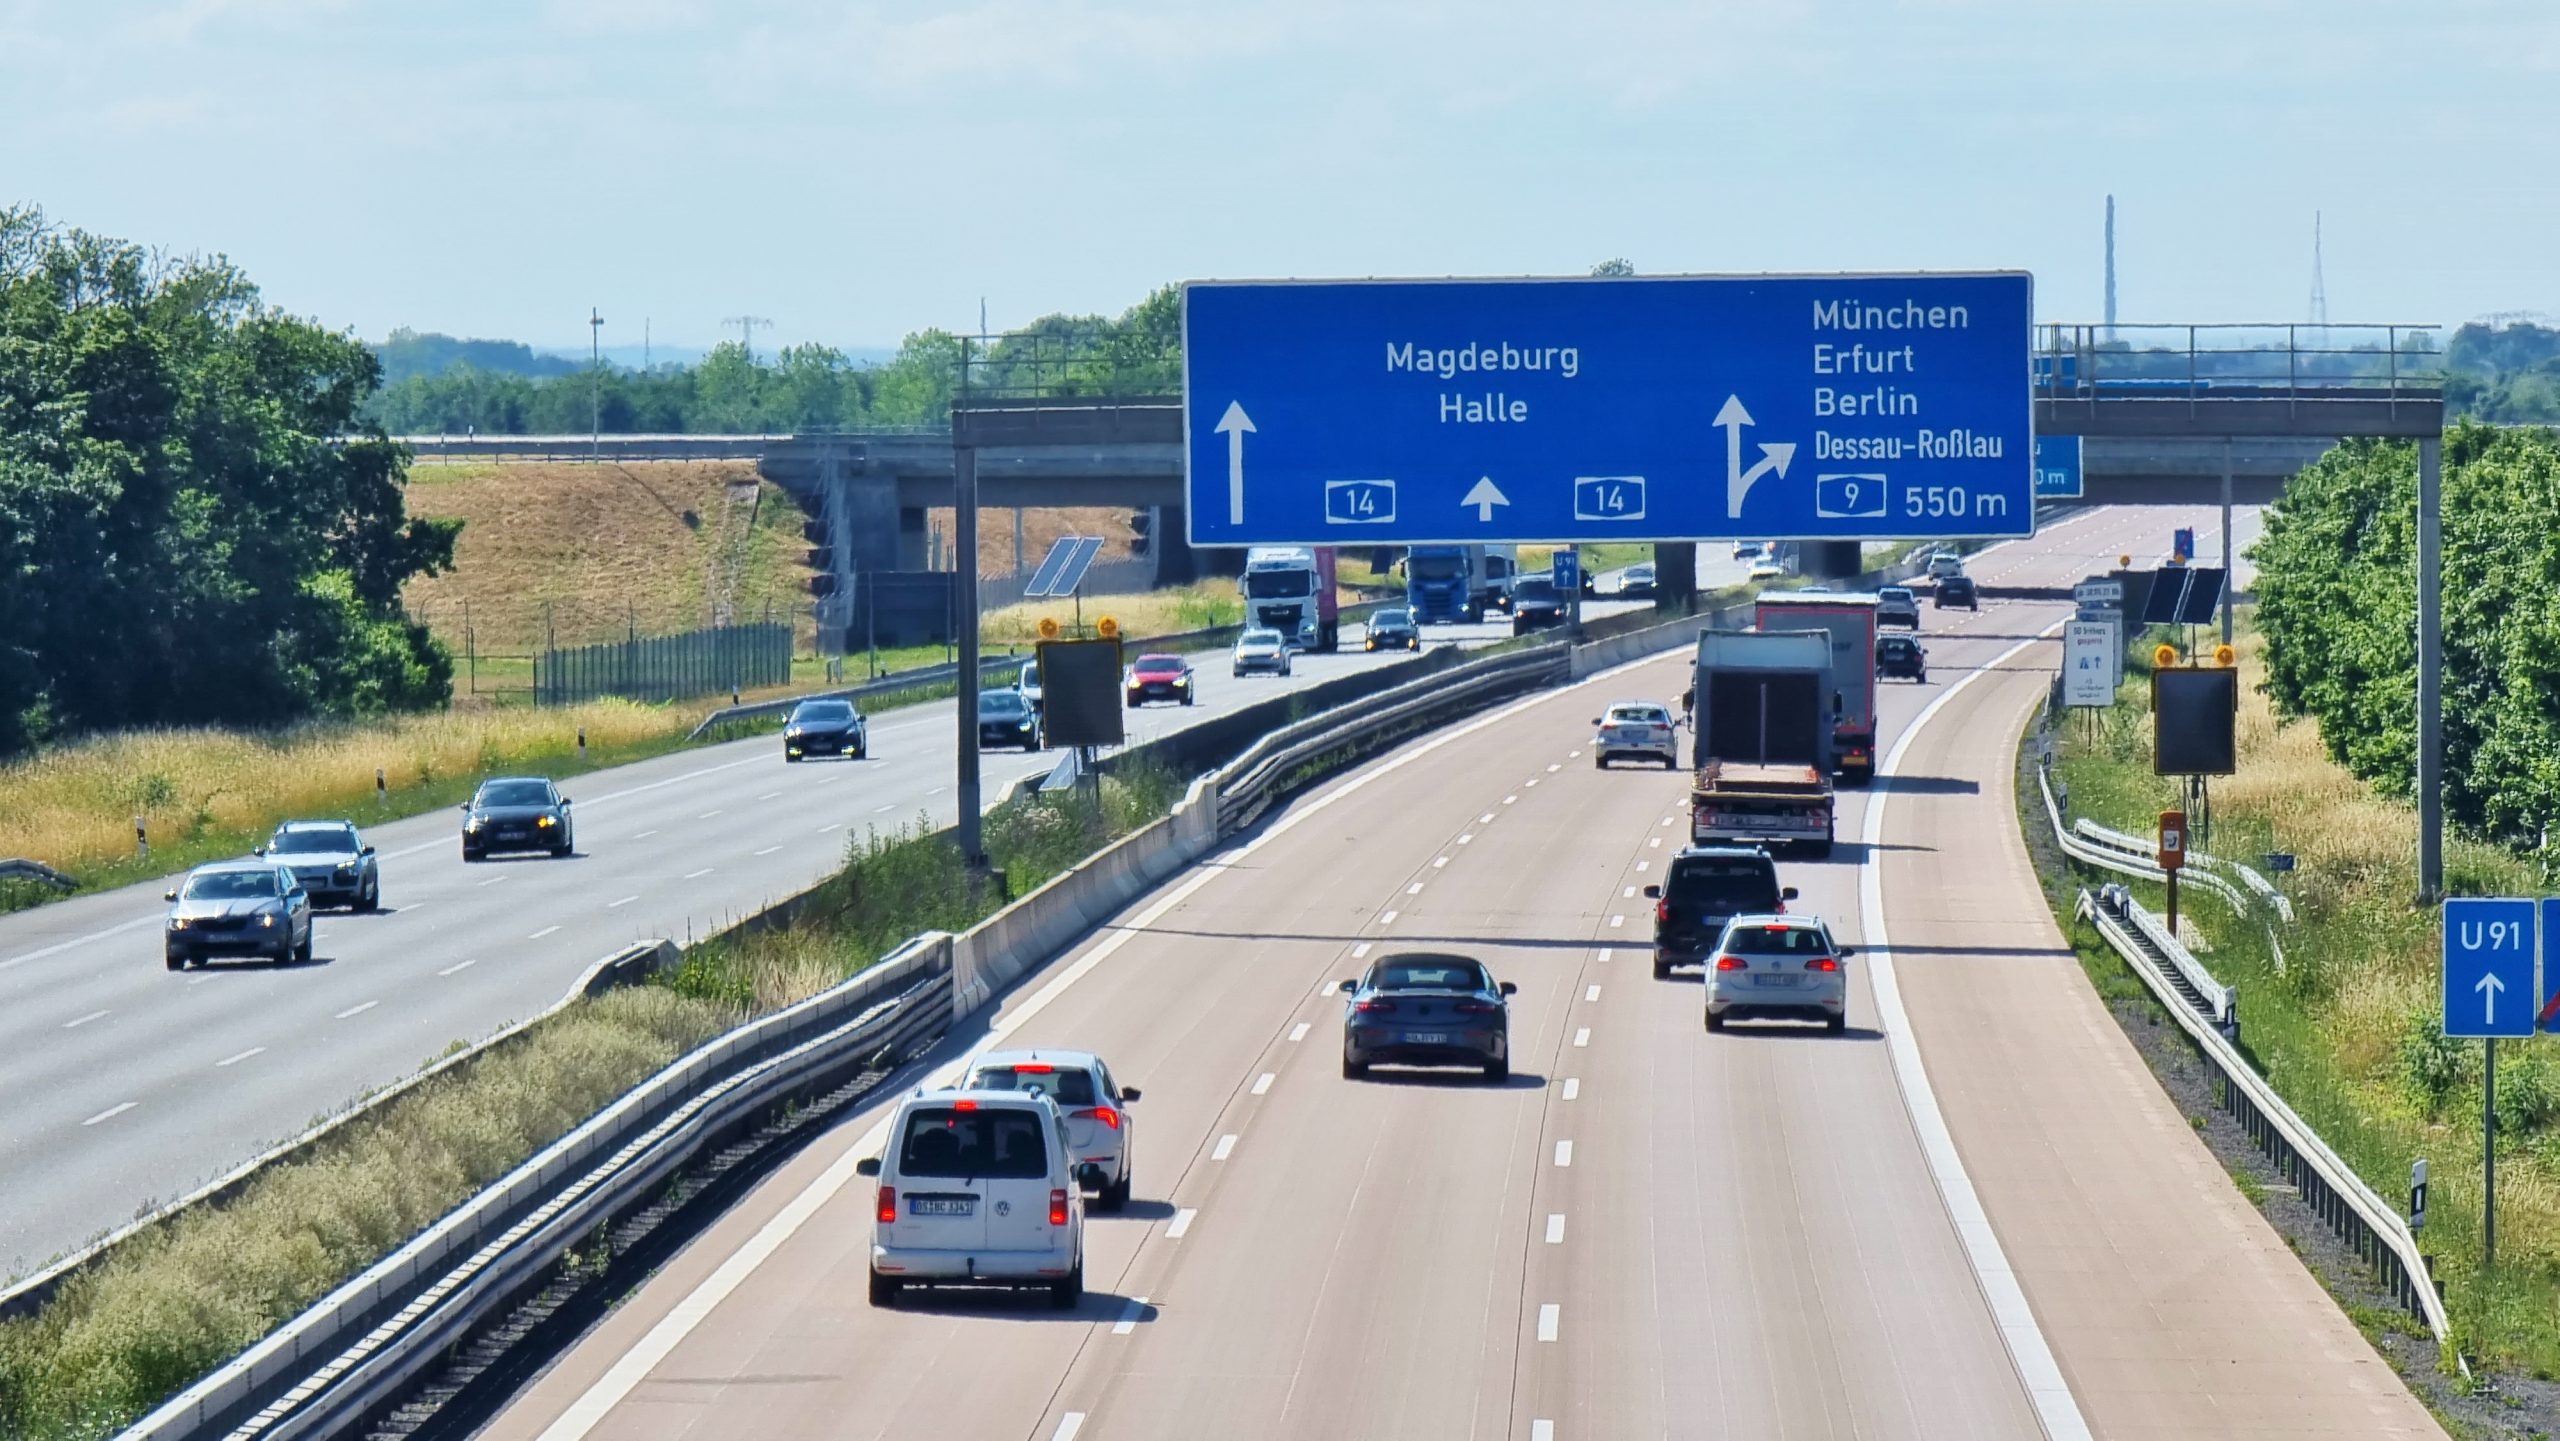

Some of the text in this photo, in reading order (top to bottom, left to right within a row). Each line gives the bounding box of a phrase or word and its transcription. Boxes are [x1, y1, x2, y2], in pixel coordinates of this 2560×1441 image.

[1814, 300, 1968, 330] München
[1387, 342, 1578, 379] Magdeburg
[1814, 344, 1914, 374] Erfurt
[1440, 393, 1528, 423] Halle
[1815, 387, 1918, 416] Berlin
[1816, 429, 2003, 460] Dessau-Roßlau
[1347, 490, 1374, 515] 14
[1596, 486, 1623, 511] 14
[1845, 483, 1859, 508] 9
[1906, 487, 2006, 517] 550 m
